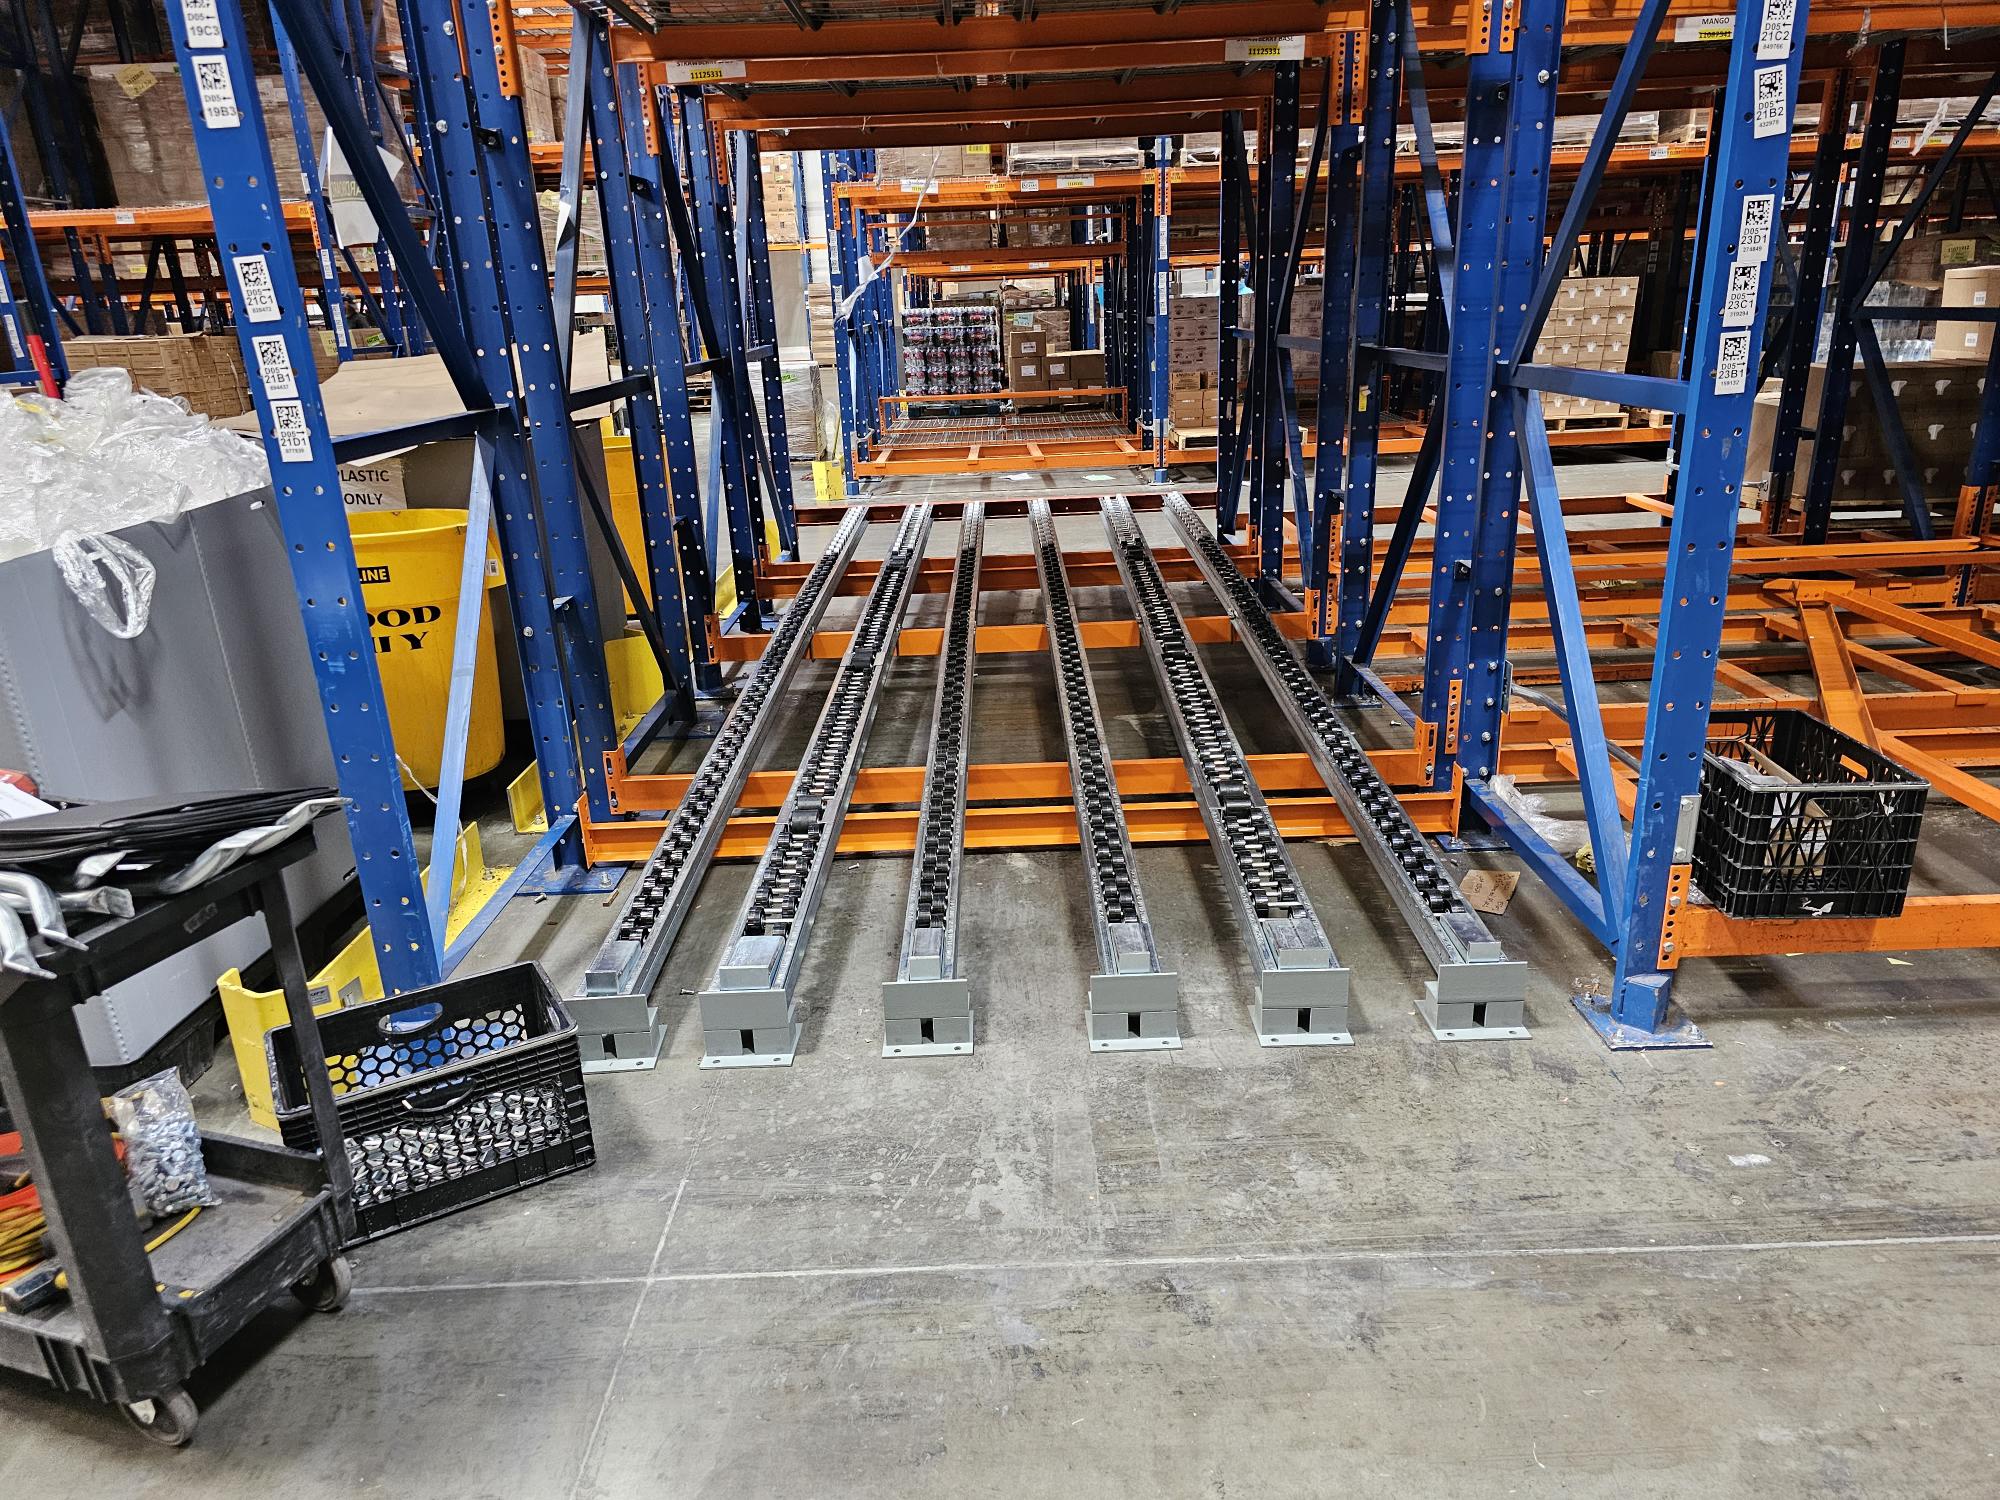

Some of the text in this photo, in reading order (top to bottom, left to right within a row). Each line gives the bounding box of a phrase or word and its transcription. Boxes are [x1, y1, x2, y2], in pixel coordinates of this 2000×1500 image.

[187, 13, 205, 21] D05
[1701, 17, 1730, 25] MANGO
[190, 25, 220, 36] 19C3
[1765, 22, 1781, 31] D05
[1761, 30, 1790, 41] 21C2
[204, 94, 221, 102] D05
[1758, 100, 1774, 110] D05
[208, 106, 237, 117] 19B3
[1756, 106, 1784, 121] 21B2
[1744, 227, 1759, 235] D05
[1740, 234, 1767, 245] 23D1
[246, 288, 263, 297] D05
[1730, 292, 1746, 300] D05
[247, 295, 274, 306] 21C1
[1728, 299, 1754, 310] 23C1
[264, 366, 280, 375] D05
[1721, 362, 1736, 370] D05
[265, 373, 291, 384] 21B1
[1718, 368, 1744, 380] 23B1
[280, 437, 307, 447] 21D1
[337, 469, 390, 482] LASTIC
[343, 493, 383, 505] ONLY
[359, 569, 388, 581] INE
[366, 605, 441, 628] OD
